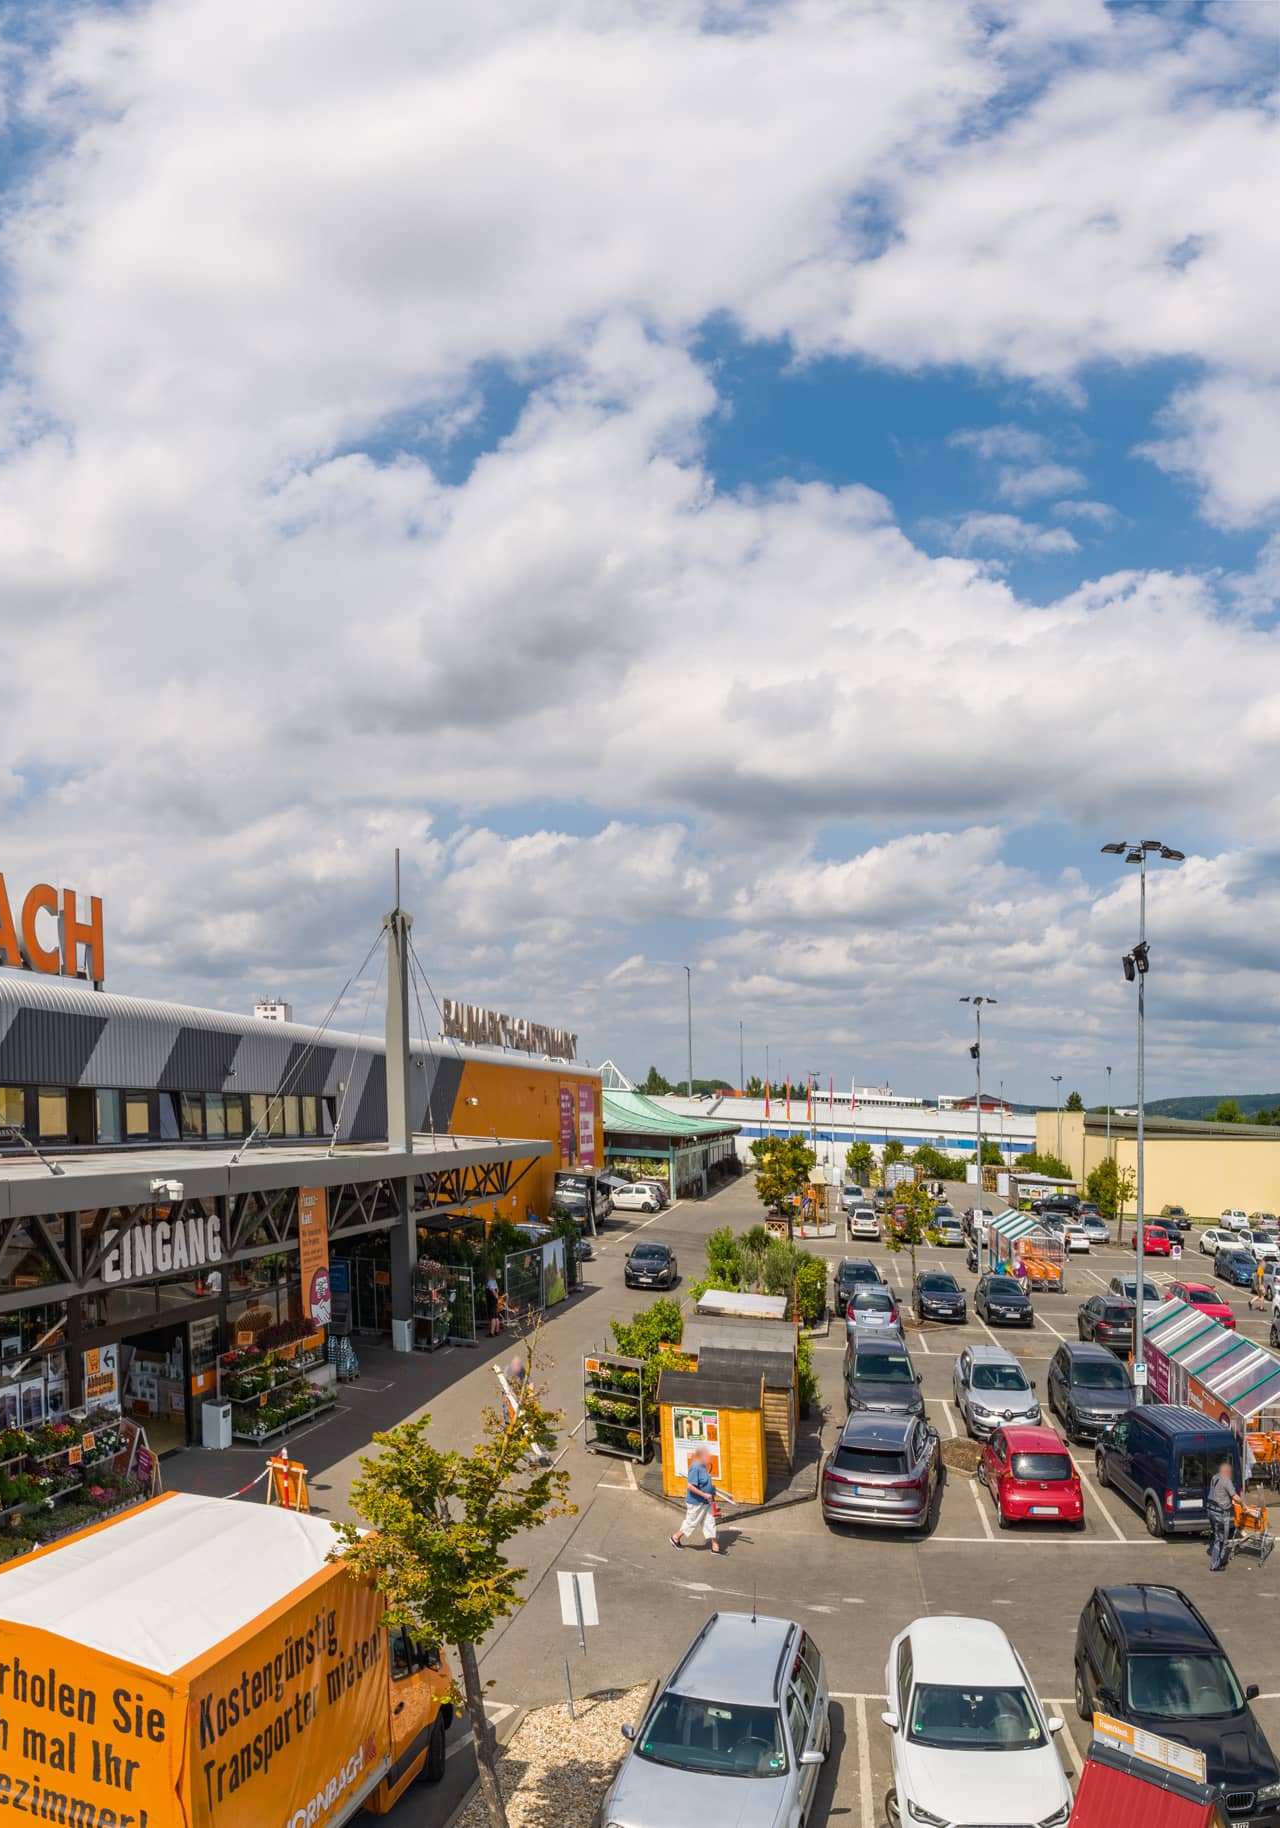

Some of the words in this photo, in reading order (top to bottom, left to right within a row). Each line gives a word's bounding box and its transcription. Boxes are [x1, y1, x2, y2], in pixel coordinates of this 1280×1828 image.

[101, 1215, 222, 1283] EINGANG
[112, 1688, 166, 1743] Sie
[199, 1606, 338, 1750] Kostengünstig
[203, 1683, 319, 1813] Transporter
[326, 1627, 383, 1705] mieten!
[22, 1726, 76, 1775] mal
[91, 1739, 141, 1792] Ihr
[286, 1744, 364, 1828] ORNBACH
